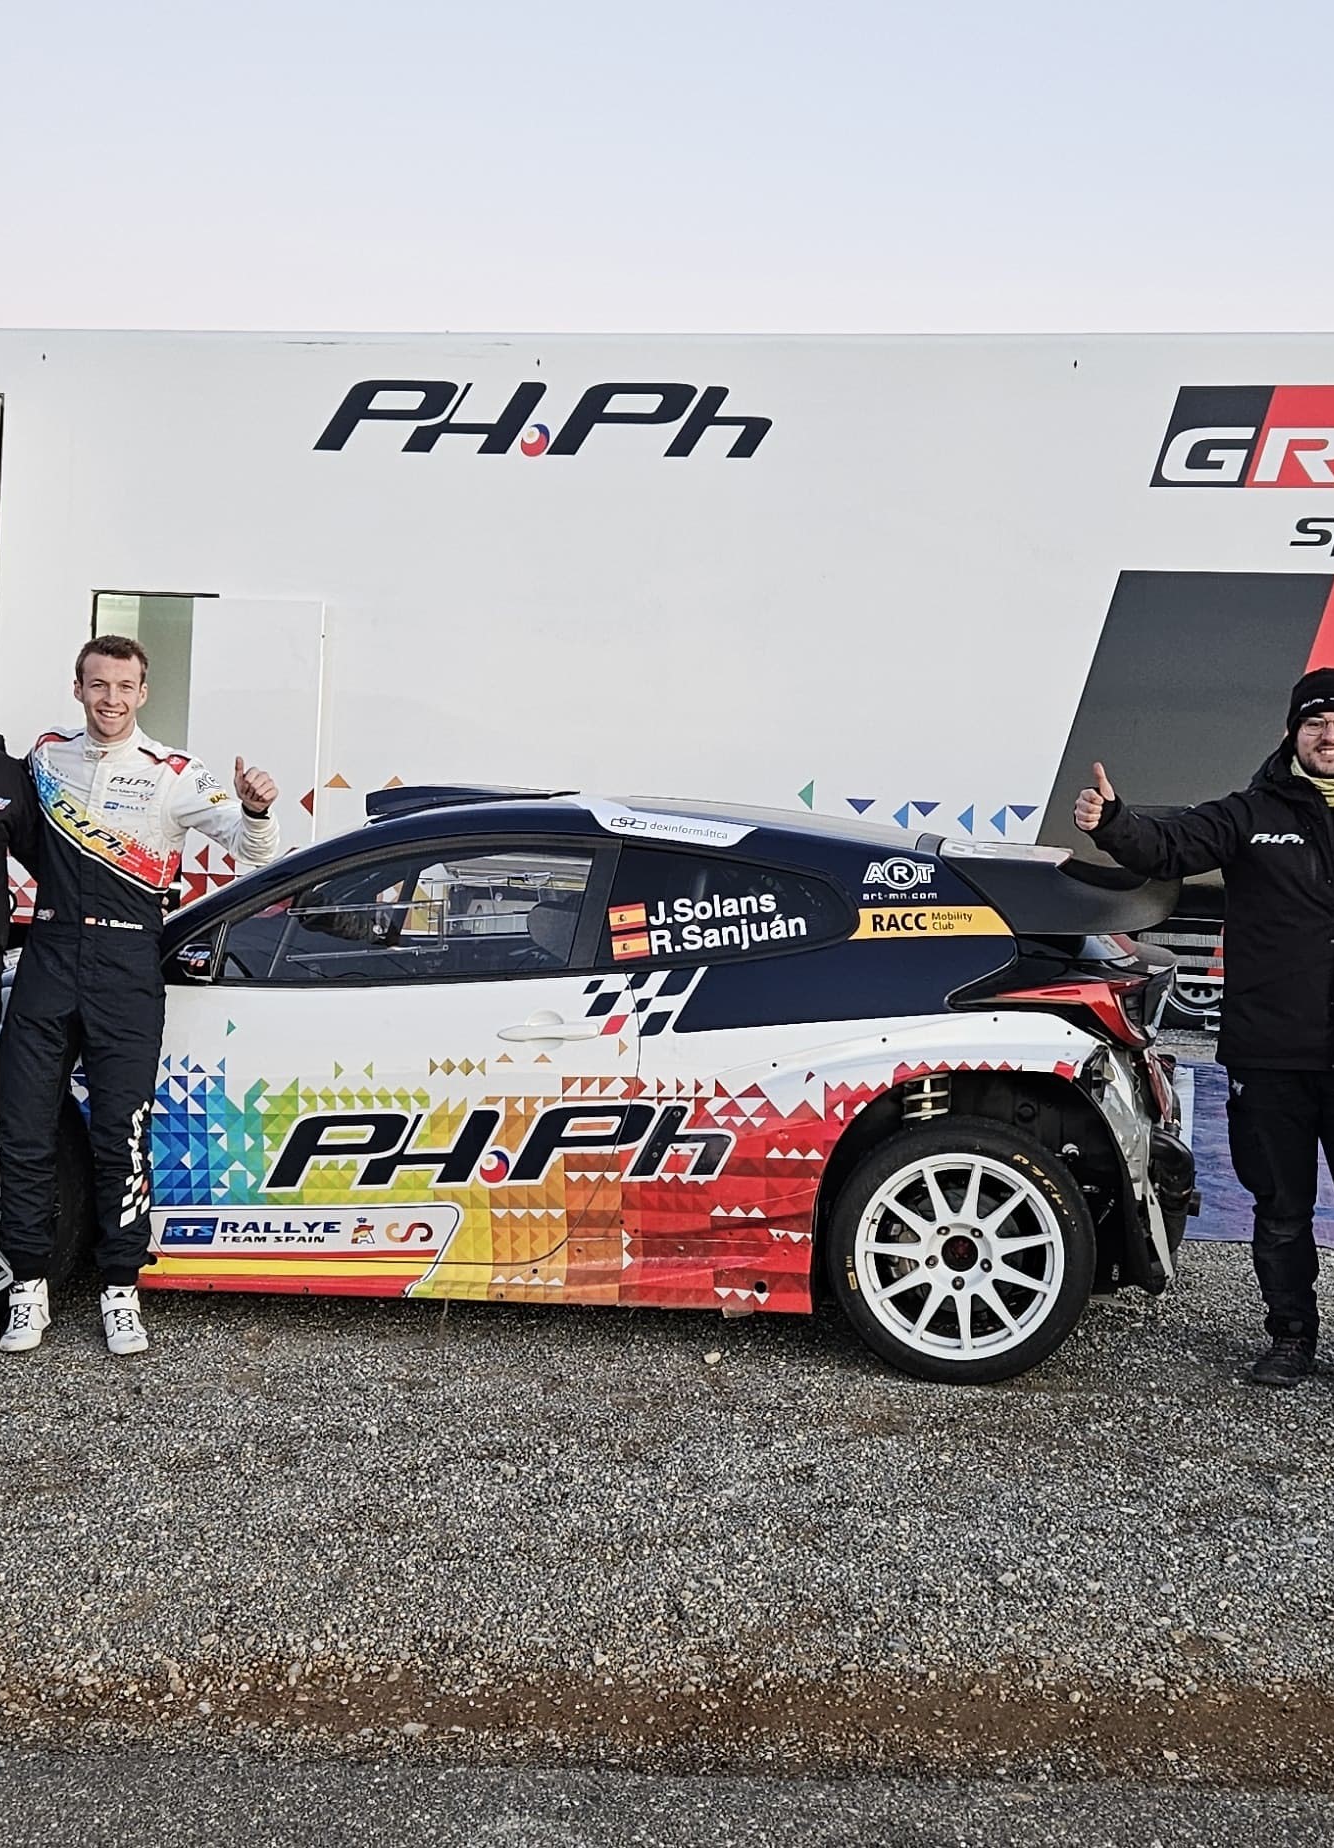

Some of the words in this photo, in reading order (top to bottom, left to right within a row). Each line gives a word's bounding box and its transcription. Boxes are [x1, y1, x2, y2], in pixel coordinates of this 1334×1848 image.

[649, 822, 728, 840] dexinformática
[862, 891, 938, 901] art-mn.com
[649, 893, 777, 926] J.Solans
[871, 912, 928, 932] RACC
[931, 911, 973, 923] Mobility
[932, 921, 955, 930] Club
[650, 913, 808, 956] R.Sanjuán
[220, 1221, 342, 1234] RALLYE
[273, 1235, 326, 1243] SPAIN
